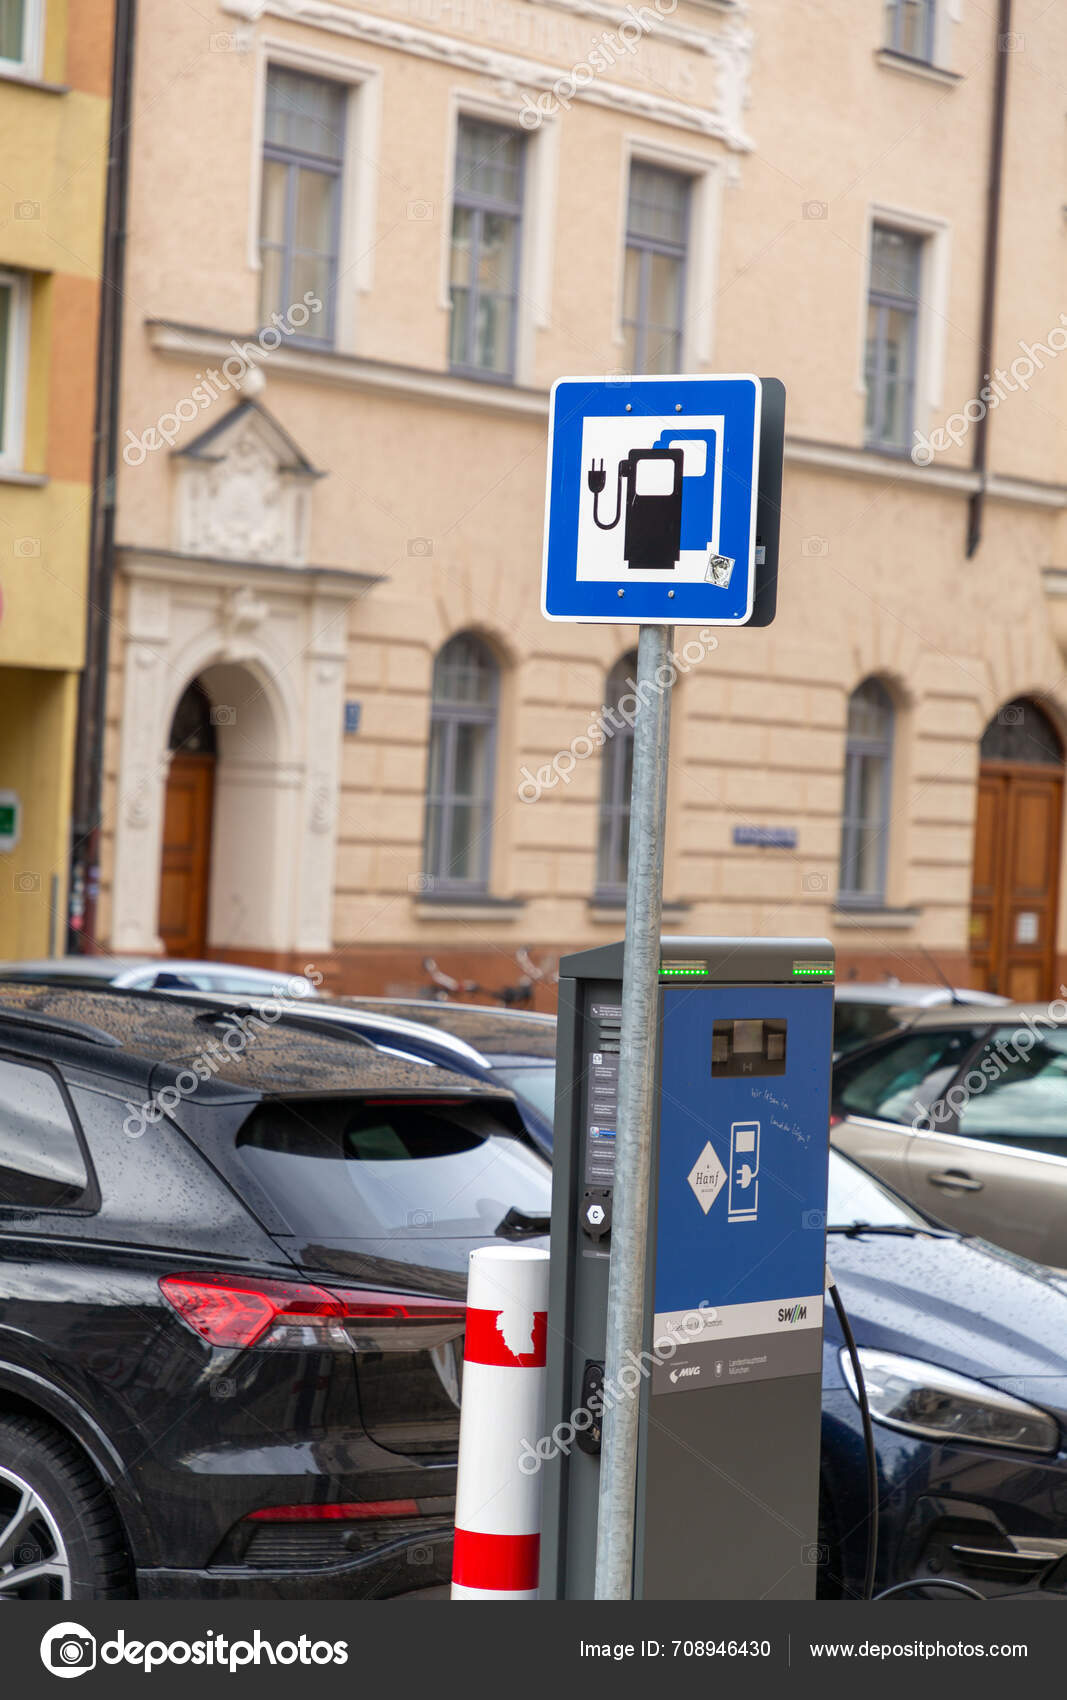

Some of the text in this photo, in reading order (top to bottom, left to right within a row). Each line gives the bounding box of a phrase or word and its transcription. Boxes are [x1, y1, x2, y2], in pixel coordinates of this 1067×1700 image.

[696, 1170, 719, 1187] Hanf
[592, 1210, 599, 1219] C
[679, 1366, 700, 1377] MVG
